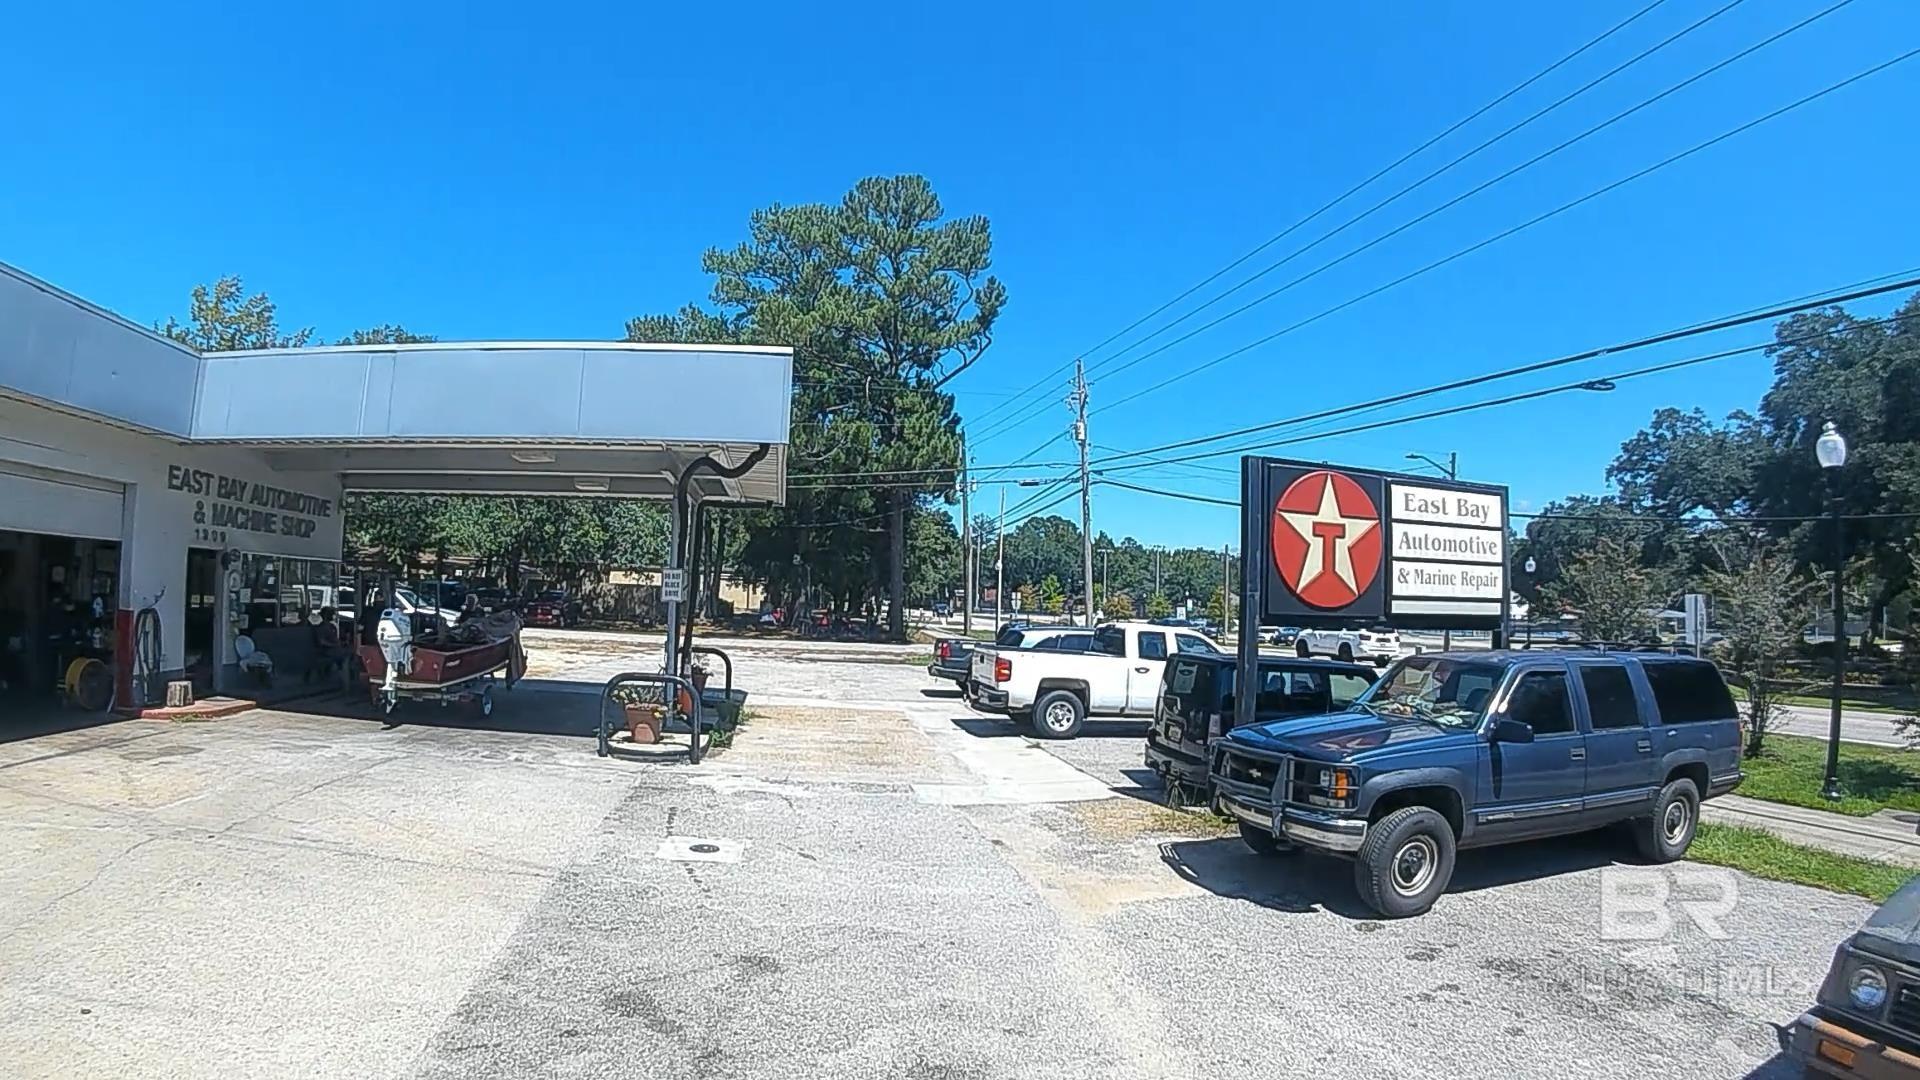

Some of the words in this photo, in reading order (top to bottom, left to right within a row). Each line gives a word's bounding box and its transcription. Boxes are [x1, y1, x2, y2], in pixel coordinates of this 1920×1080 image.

[167, 464, 215, 496] EAST
[217, 475, 248, 502] BAY
[249, 484, 332, 518] AUTOMOTIVE
[193, 500, 206, 525] &
[211, 503, 278, 534] MACHINE
[280, 514, 317, 538] SHOP
[1404, 492, 1449, 516] East
[1456, 498, 1490, 524] Bay
[1398, 531, 1498, 556] Automotive
[1397, 567, 1410, 585] &
[1414, 568, 1457, 586] Marine
[1460, 570, 1499, 592] Repair
